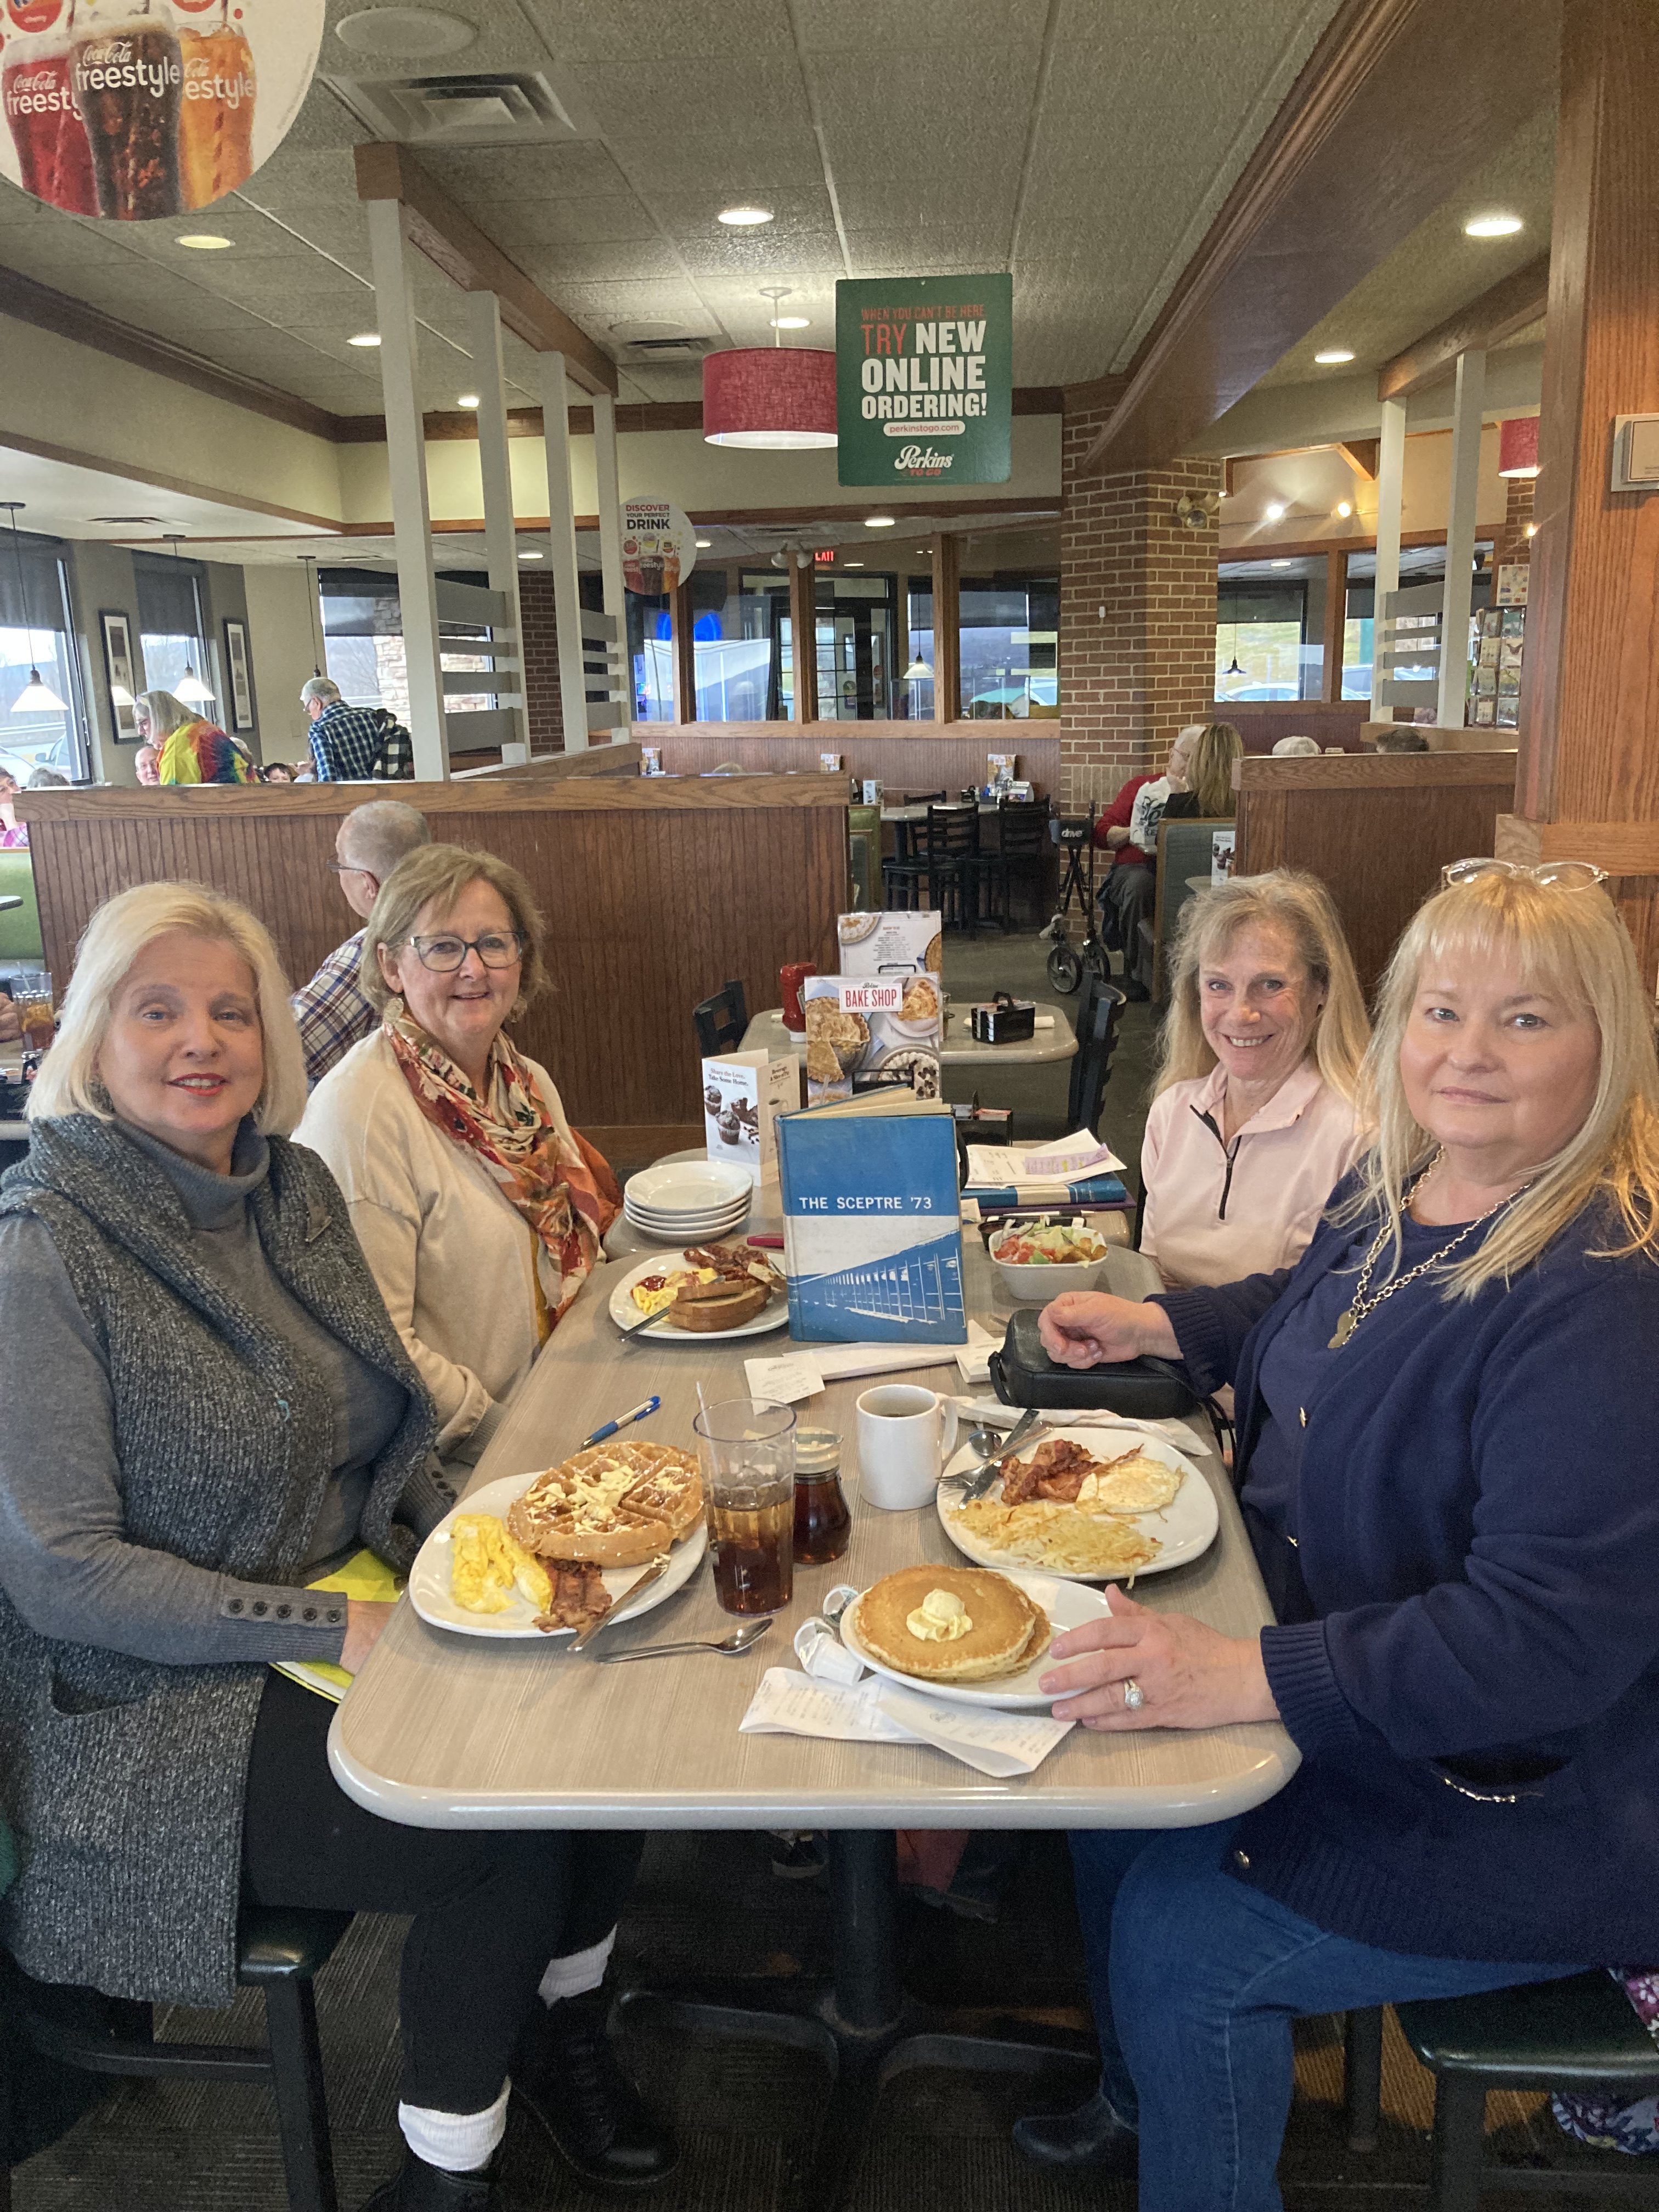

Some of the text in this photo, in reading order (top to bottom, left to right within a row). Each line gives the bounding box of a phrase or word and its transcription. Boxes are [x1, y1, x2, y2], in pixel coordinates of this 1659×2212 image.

[75, 56, 180, 98] freestyle
[861, 307, 889, 321] WHEN
[892, 306, 911, 320] YOU
[915, 305, 942, 319] CAN'T
[945, 305, 956, 318] BE
[860, 320, 986, 356] TRY NEW
[861, 355, 986, 393] ONLINE
[861, 392, 988, 420] ORDERING!
[889, 424, 960, 434] perkinstogo.com
[894, 444, 953, 470] Perkins
[910, 467, 942, 476] TO GO
[627, 518, 670, 530] DRINK
[845, 989, 897, 1007] BAKE SHOP
[799, 1197, 932, 1209] THE SCEPTRE '73
